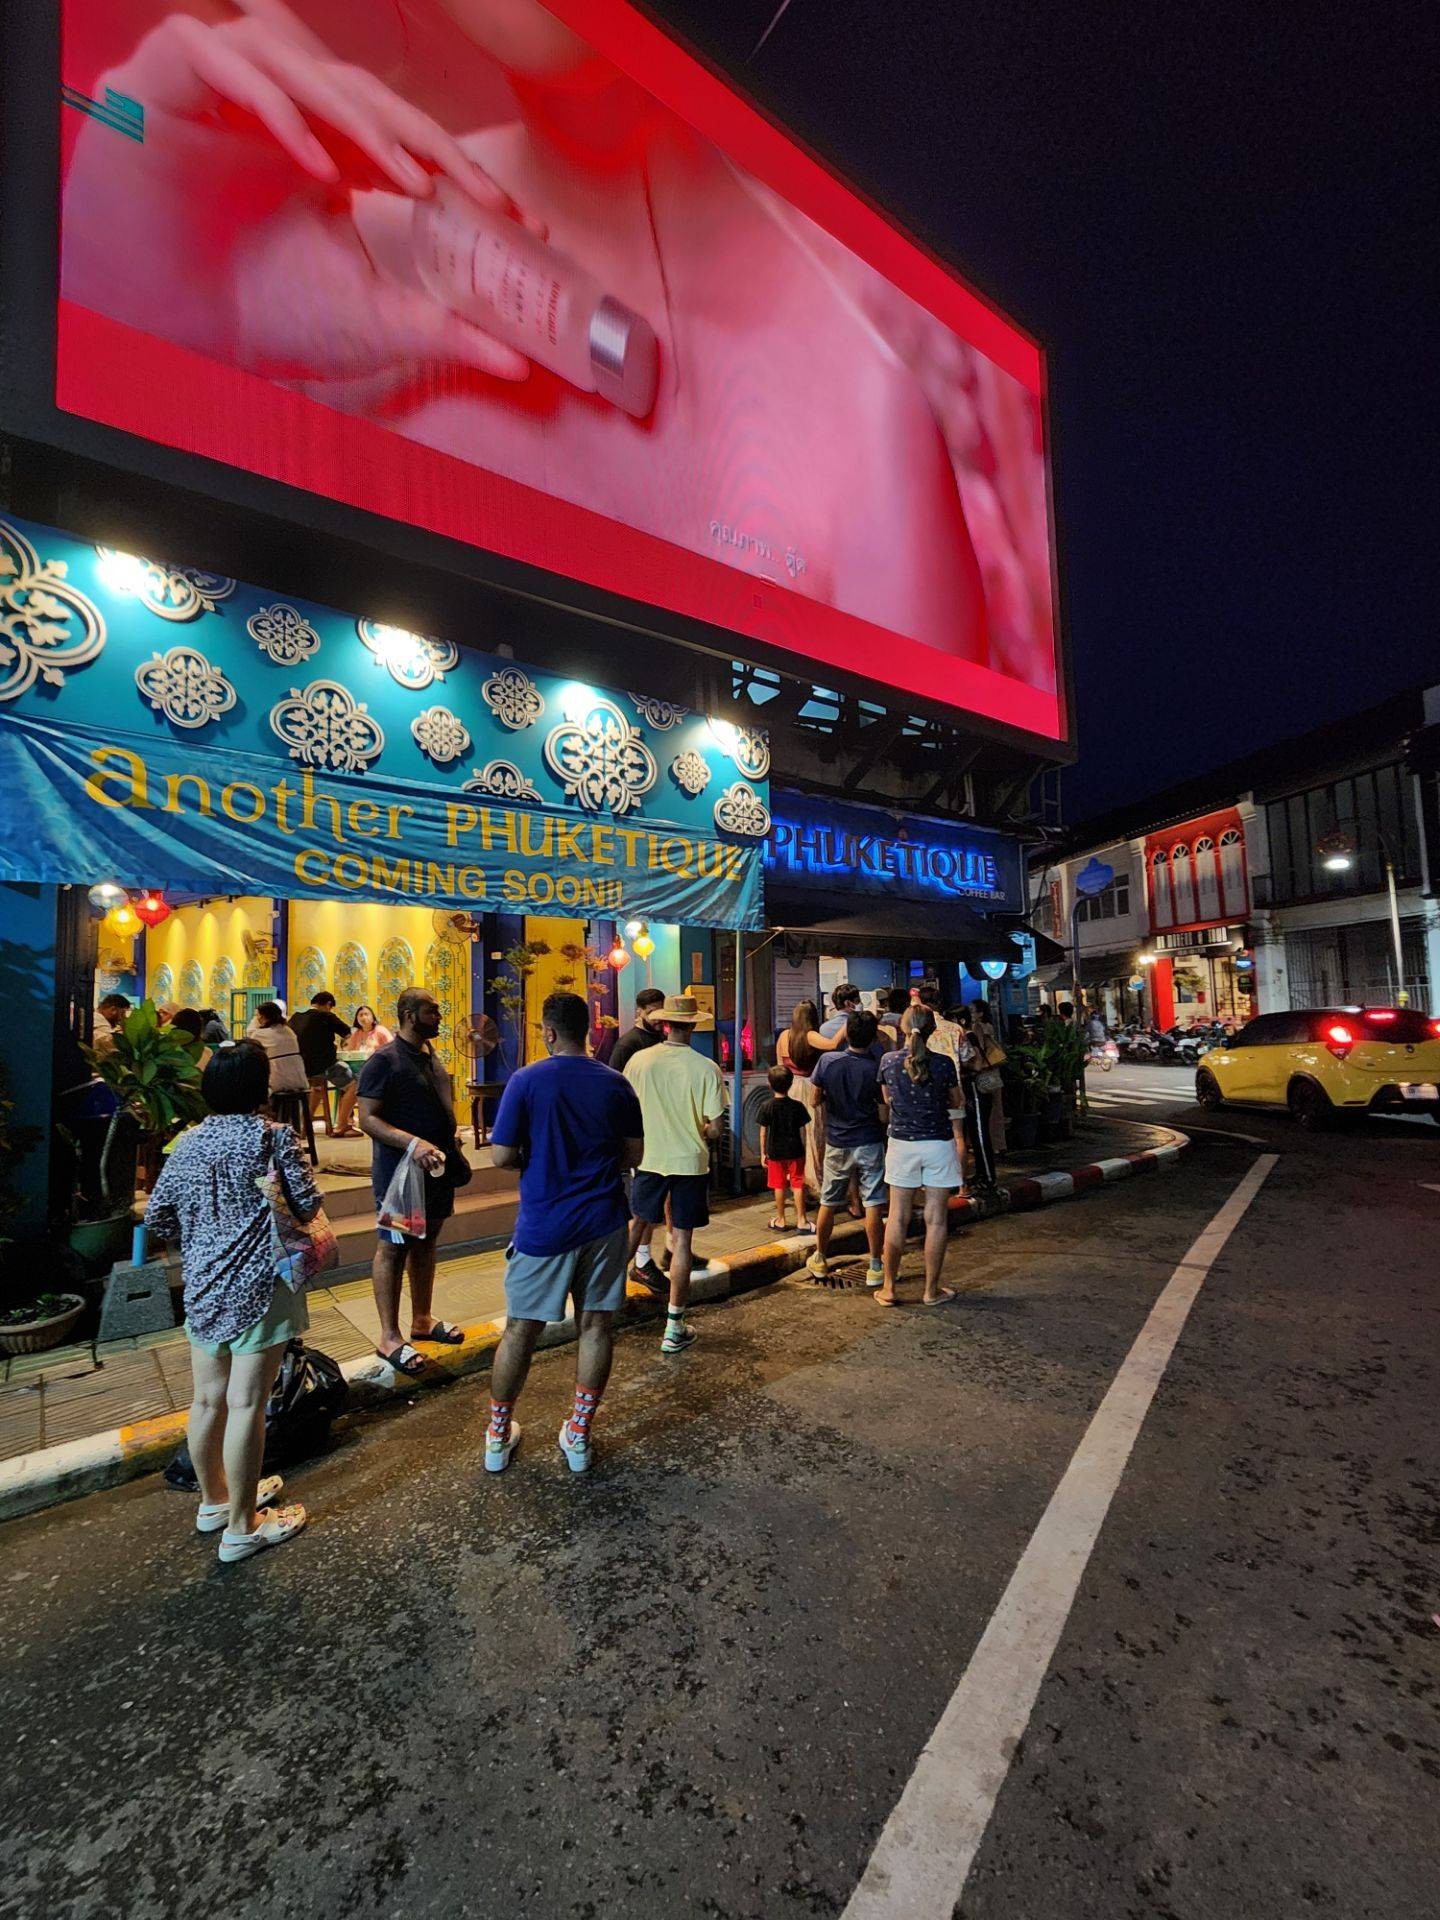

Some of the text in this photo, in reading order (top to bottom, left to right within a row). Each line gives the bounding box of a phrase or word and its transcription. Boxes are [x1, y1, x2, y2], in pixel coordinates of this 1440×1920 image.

[84, 746, 742, 881] another PHUKETIQUE
[294, 849, 623, 909] COMING SOON!!
[766, 824, 997, 890] PHUKETIQUE
[957, 888, 1006, 901] COFFEE BAR
